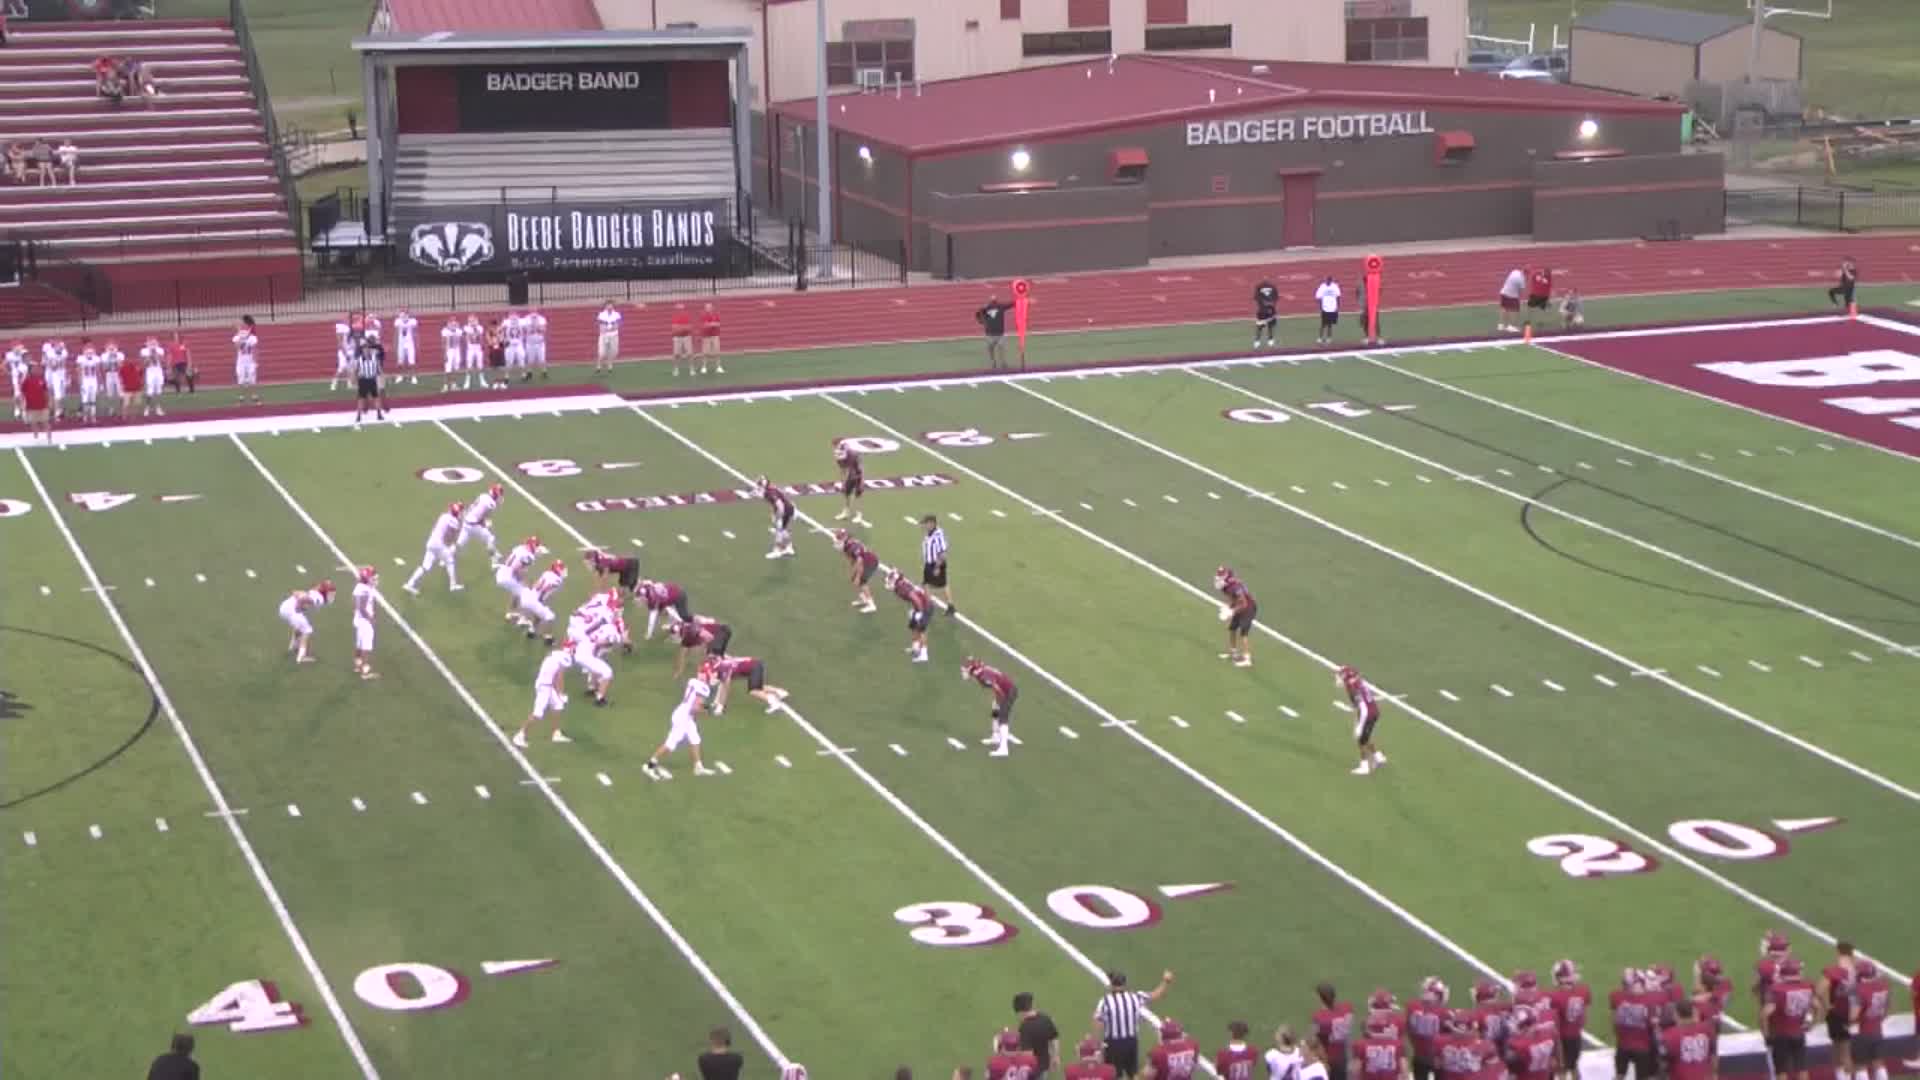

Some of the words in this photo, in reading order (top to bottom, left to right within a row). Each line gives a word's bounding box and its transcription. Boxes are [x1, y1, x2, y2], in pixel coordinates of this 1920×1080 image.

[486, 71, 573, 92] BADGER
[578, 70, 641, 90] BAND
[1186, 119, 1295, 145] BADGER
[1303, 110, 1435, 139] FOOTBALL
[571, 210, 644, 250] BADGER
[652, 208, 715, 248] BANDS
